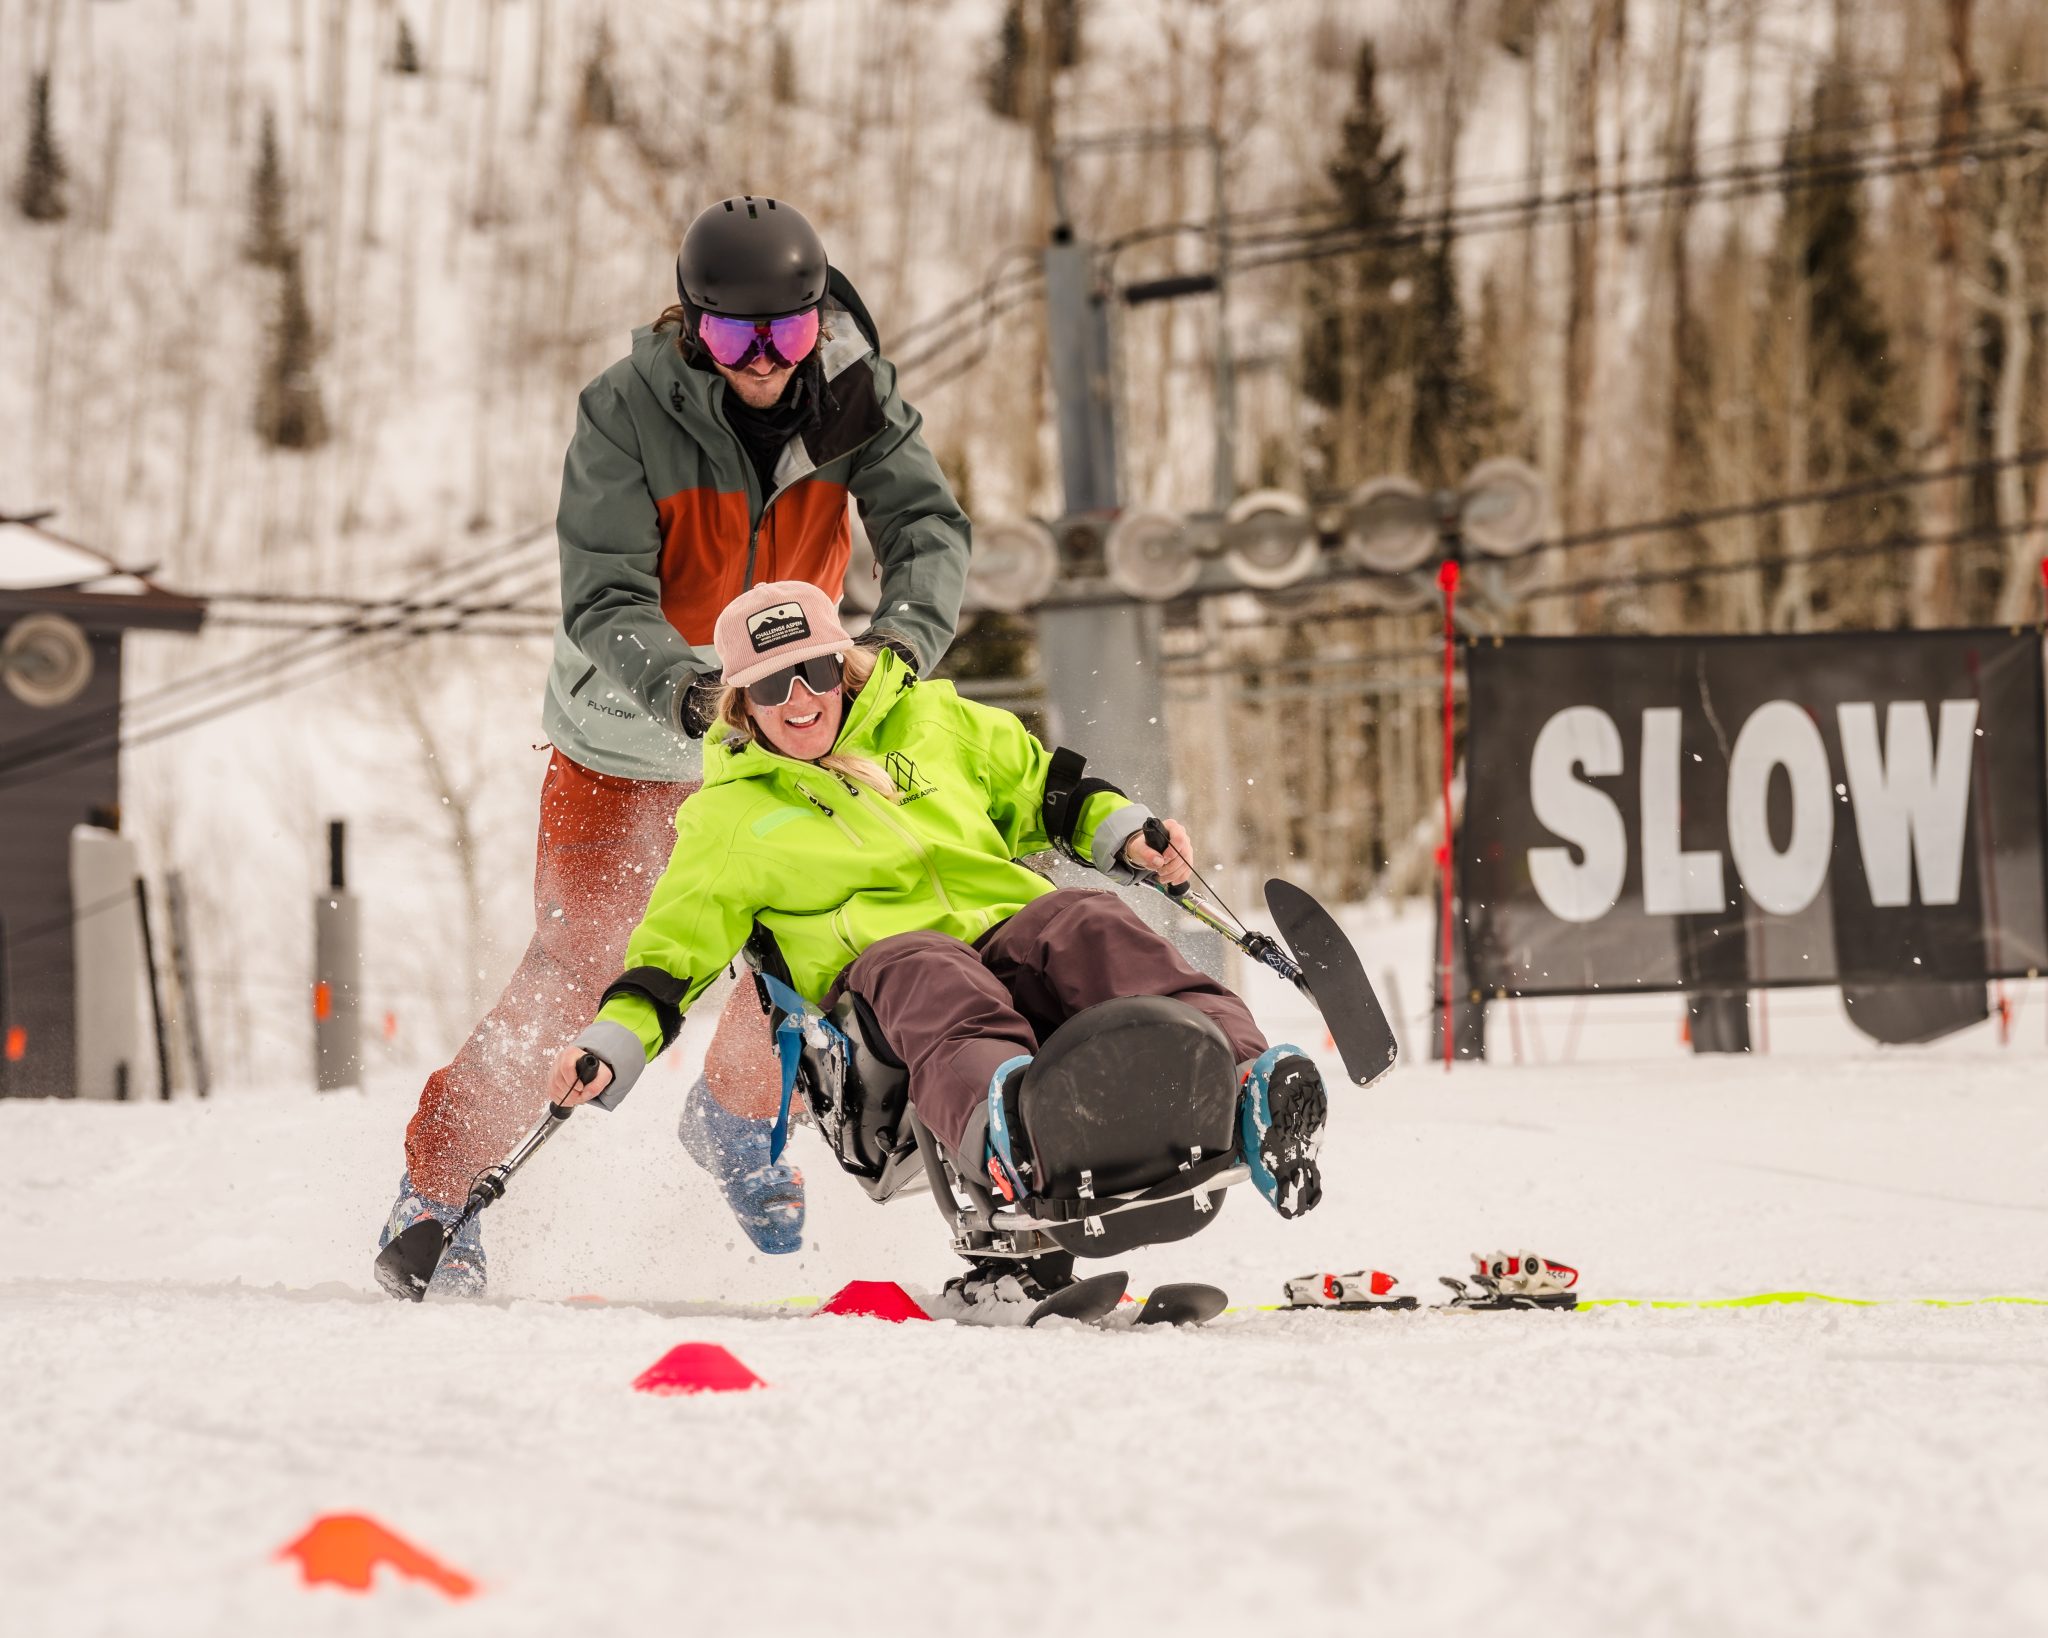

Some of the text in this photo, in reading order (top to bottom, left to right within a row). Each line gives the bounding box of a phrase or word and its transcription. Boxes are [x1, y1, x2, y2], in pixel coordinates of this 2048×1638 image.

[755, 625, 785, 639] CHALLENGE
[786, 621, 803, 629] ASPEN
[587, 700, 636, 721] FLYLOW
[1527, 700, 1979, 922] SLOW
